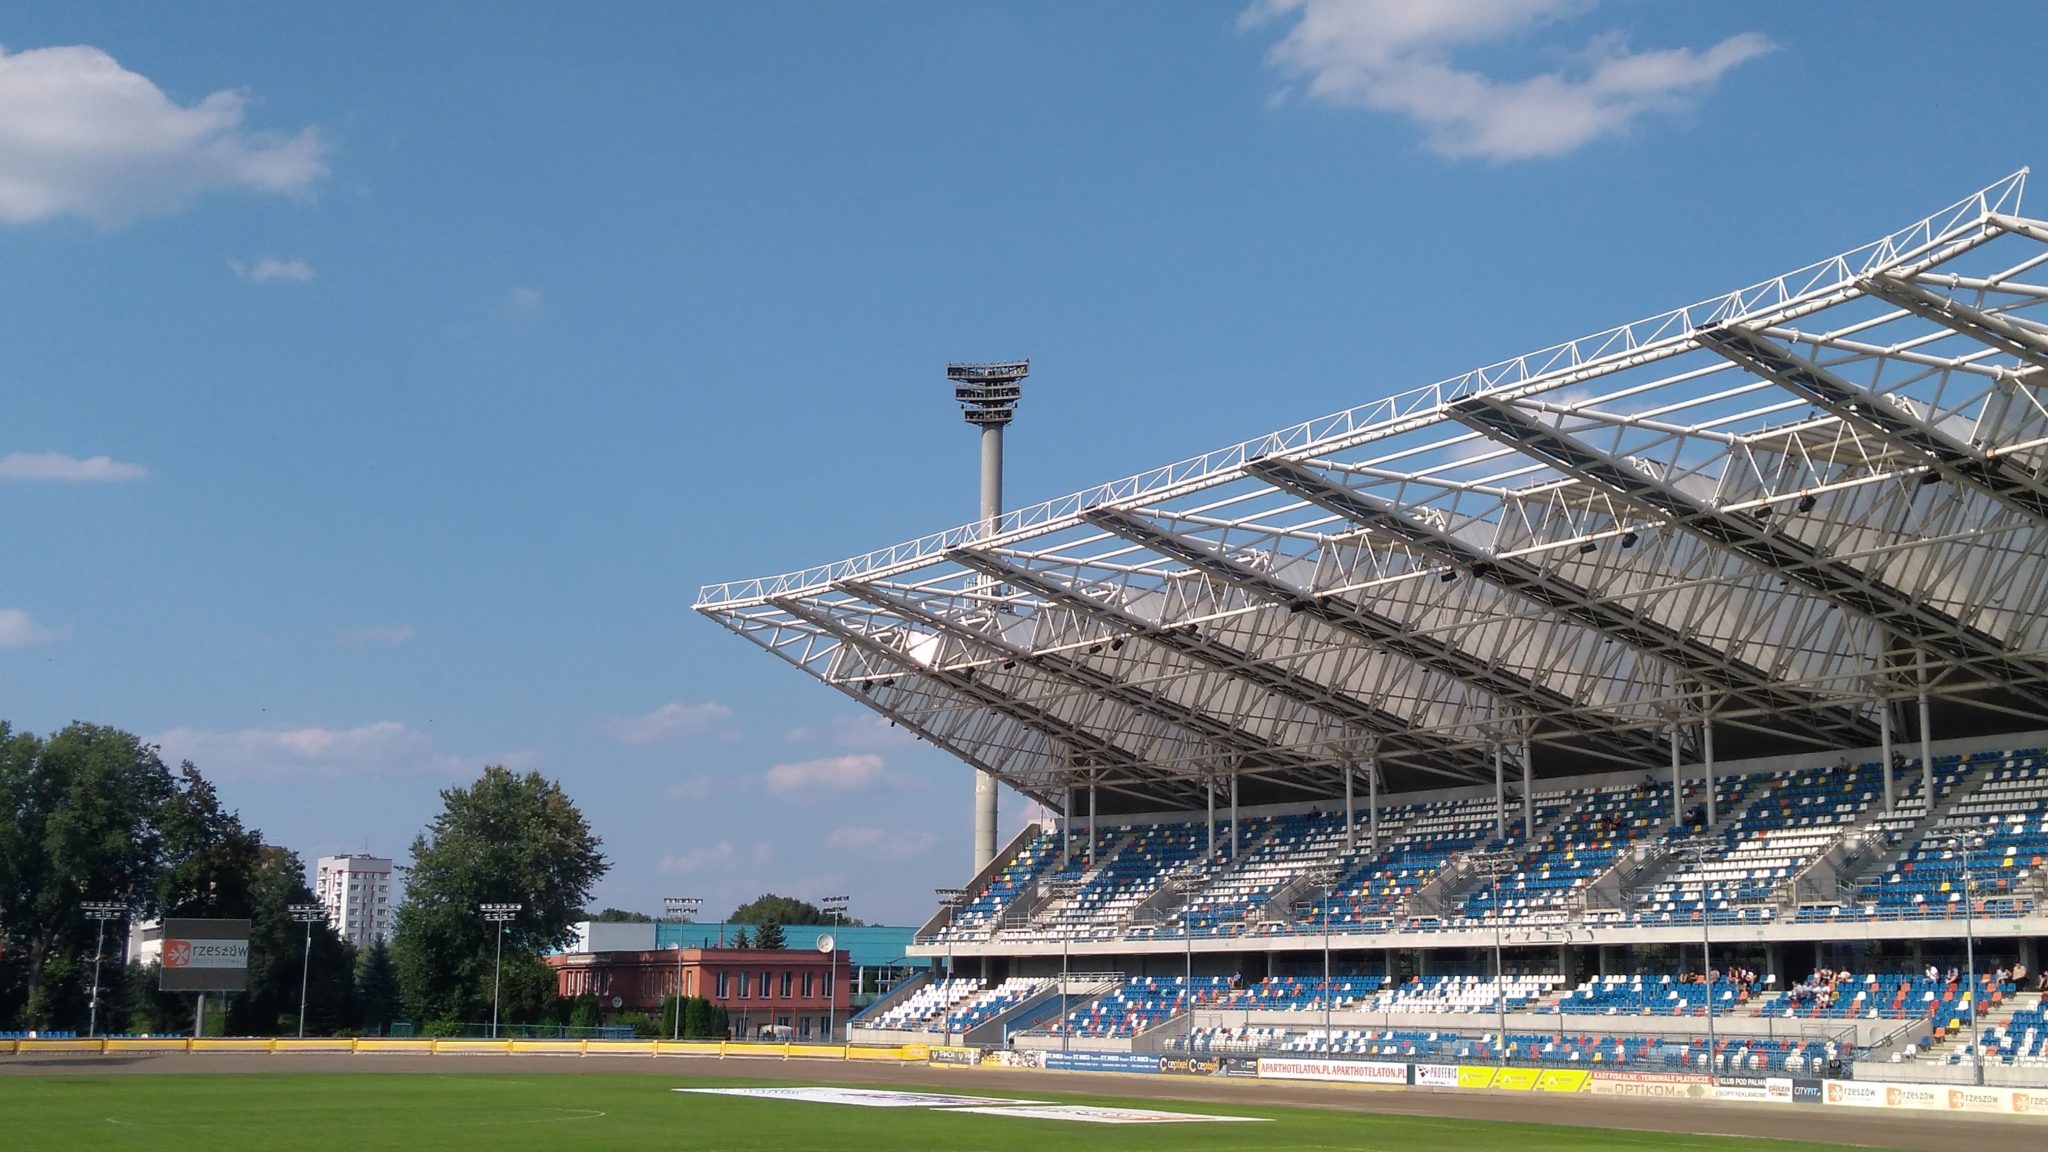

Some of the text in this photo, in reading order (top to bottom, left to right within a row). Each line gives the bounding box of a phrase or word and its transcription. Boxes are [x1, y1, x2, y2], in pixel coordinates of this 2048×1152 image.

[1261, 1063, 1330, 1075] APARTHOTELATON.PL
[1331, 1065, 1407, 1079] APARTHOTELATON.PL
[1844, 1087, 1876, 1096] rzeszów
[1902, 1091, 1935, 1099] rzeszów
